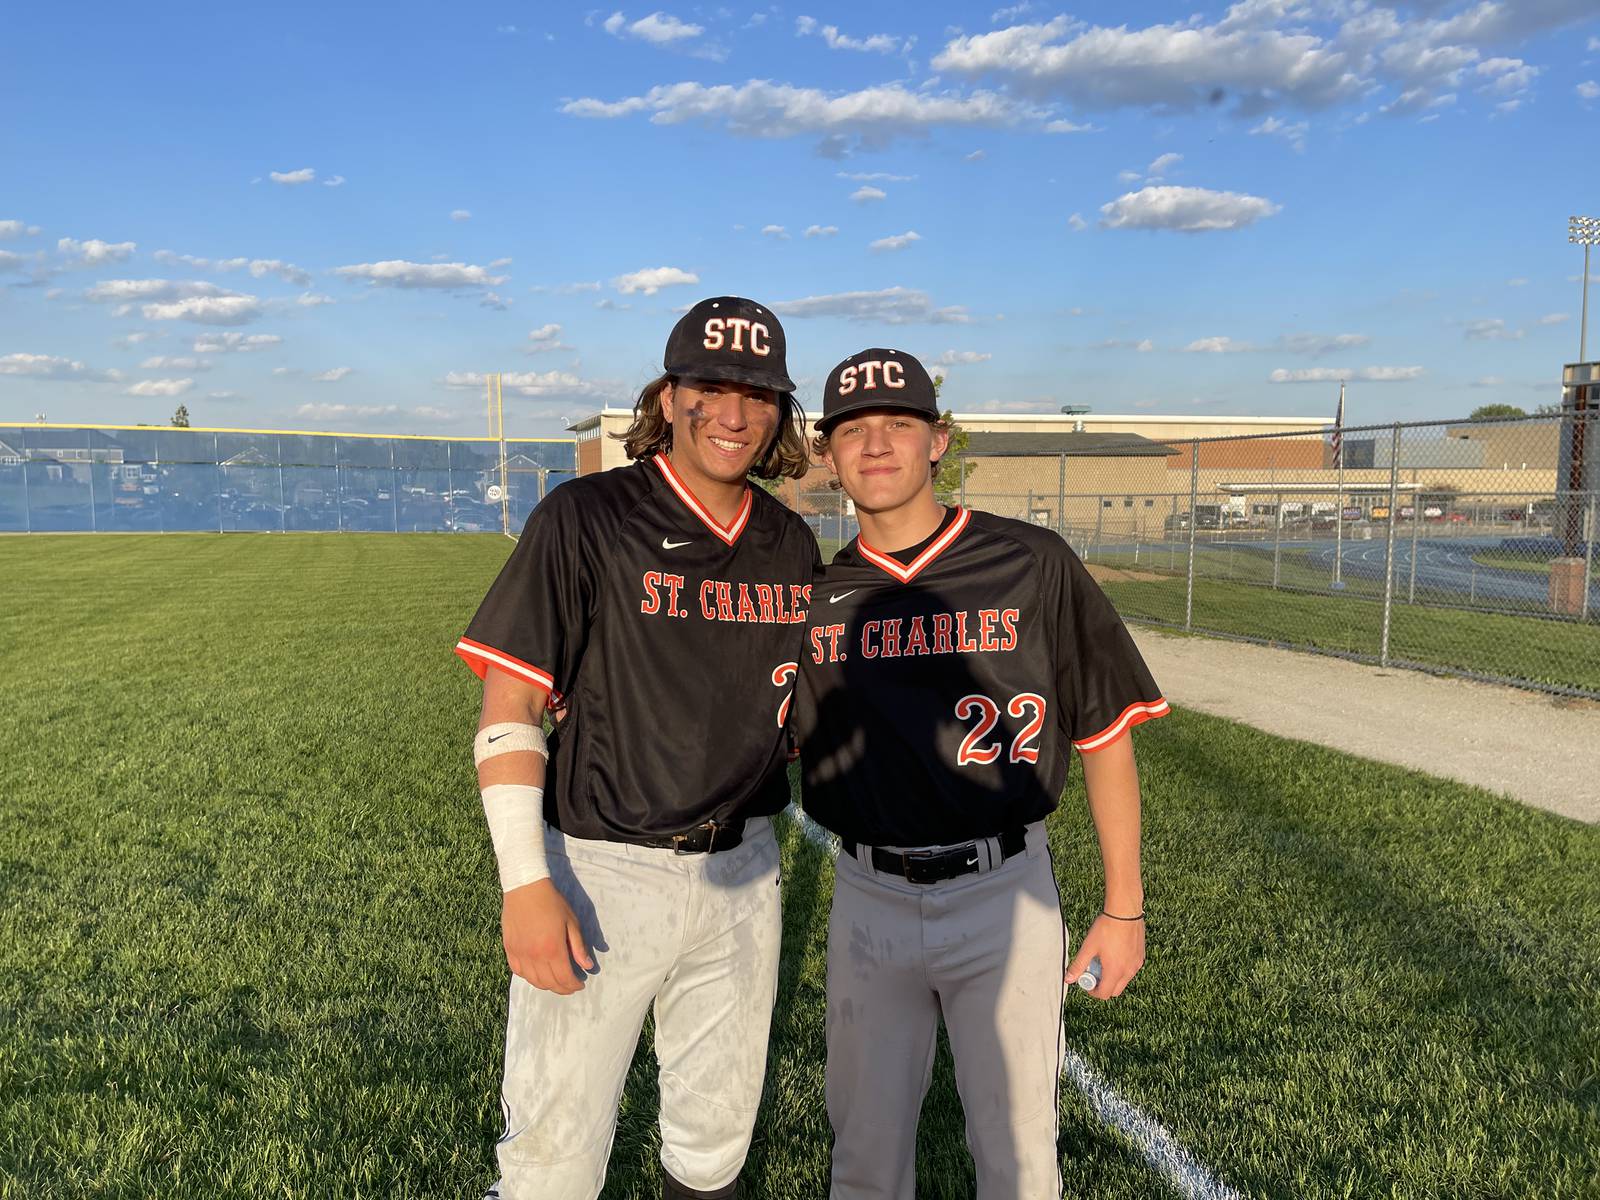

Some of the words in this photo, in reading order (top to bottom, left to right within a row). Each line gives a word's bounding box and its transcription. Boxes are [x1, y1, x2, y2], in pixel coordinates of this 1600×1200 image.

[703, 318, 770, 356] STC
[838, 360, 906, 396] STC
[641, 570, 688, 618] ST.
[810, 623, 847, 664] ST.
[861, 608, 1020, 658] CHARLES
[955, 692, 1047, 766] 22
